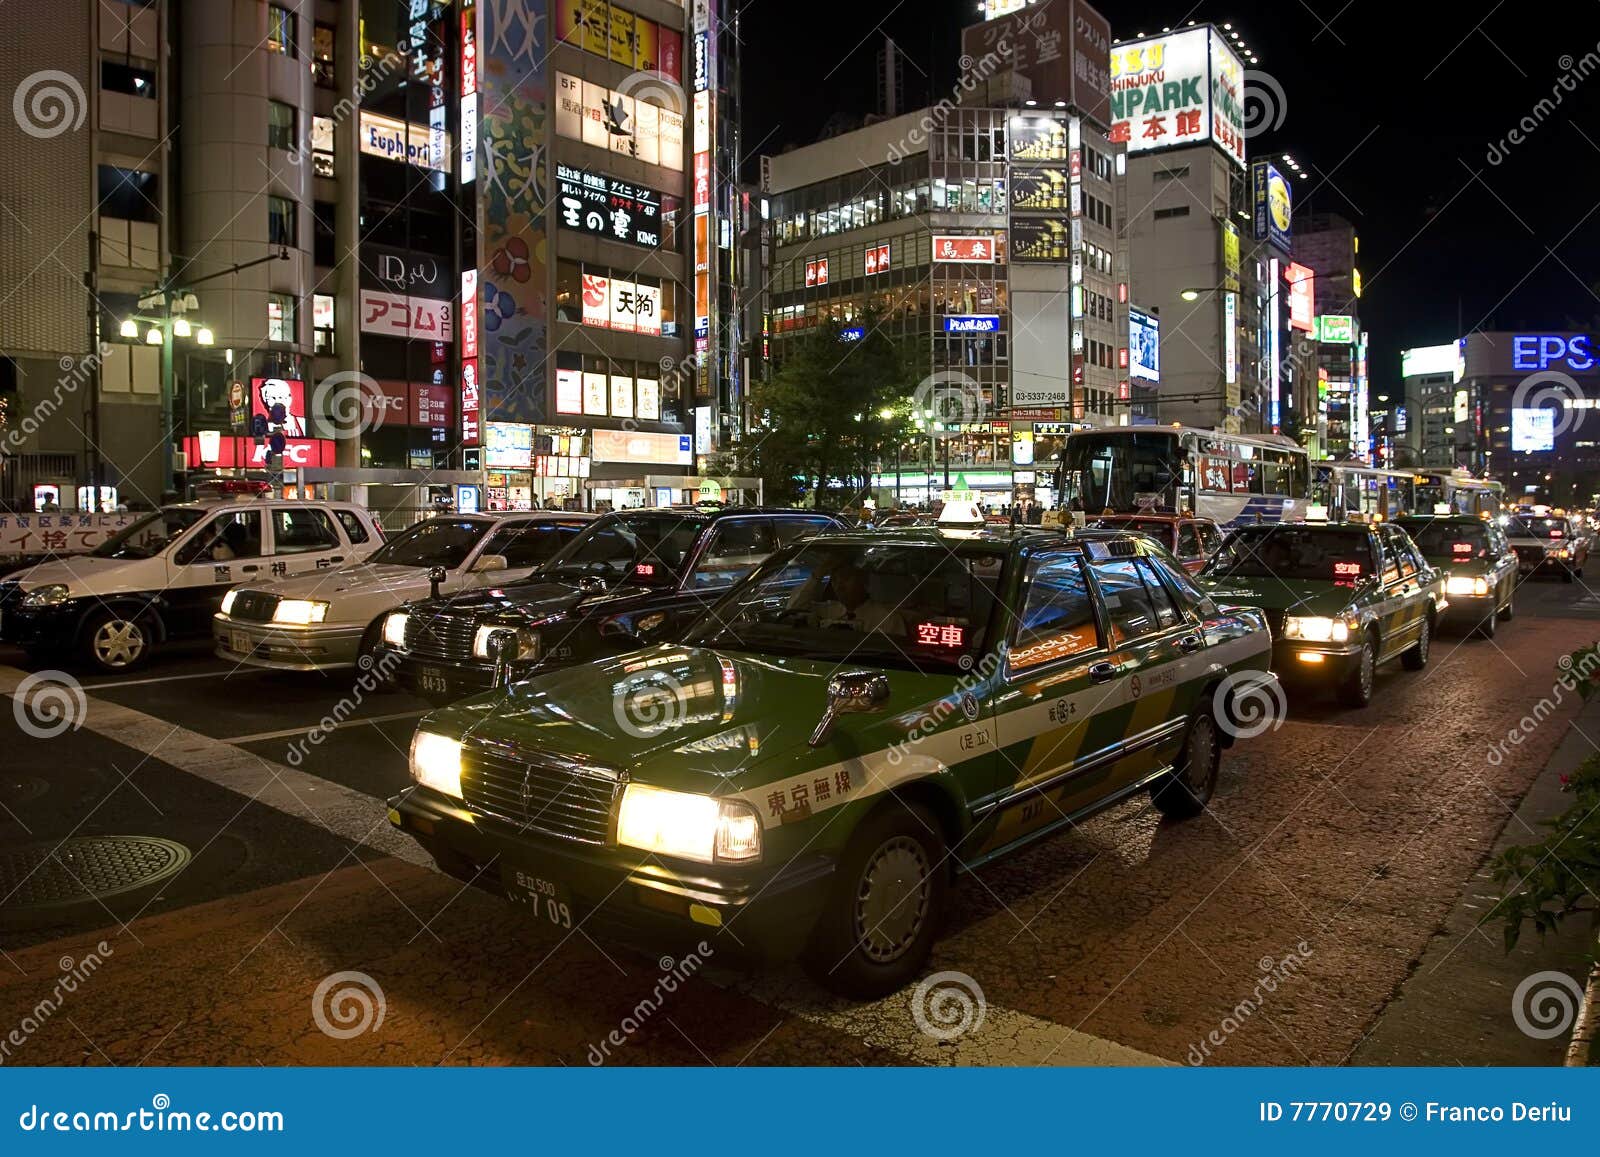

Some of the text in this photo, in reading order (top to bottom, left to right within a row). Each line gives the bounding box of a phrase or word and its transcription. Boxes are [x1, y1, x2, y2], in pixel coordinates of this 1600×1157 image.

[637, 230, 658, 246] KING
[365, 298, 437, 332] アコム
[616, 289, 655, 318] 天狗
[1015, 392, 1066, 401] 03-5337-2468
[0, 529, 159, 550] イ捨て止
[917, 622, 964, 648] 空車
[766, 769, 852, 818] 東京無線
